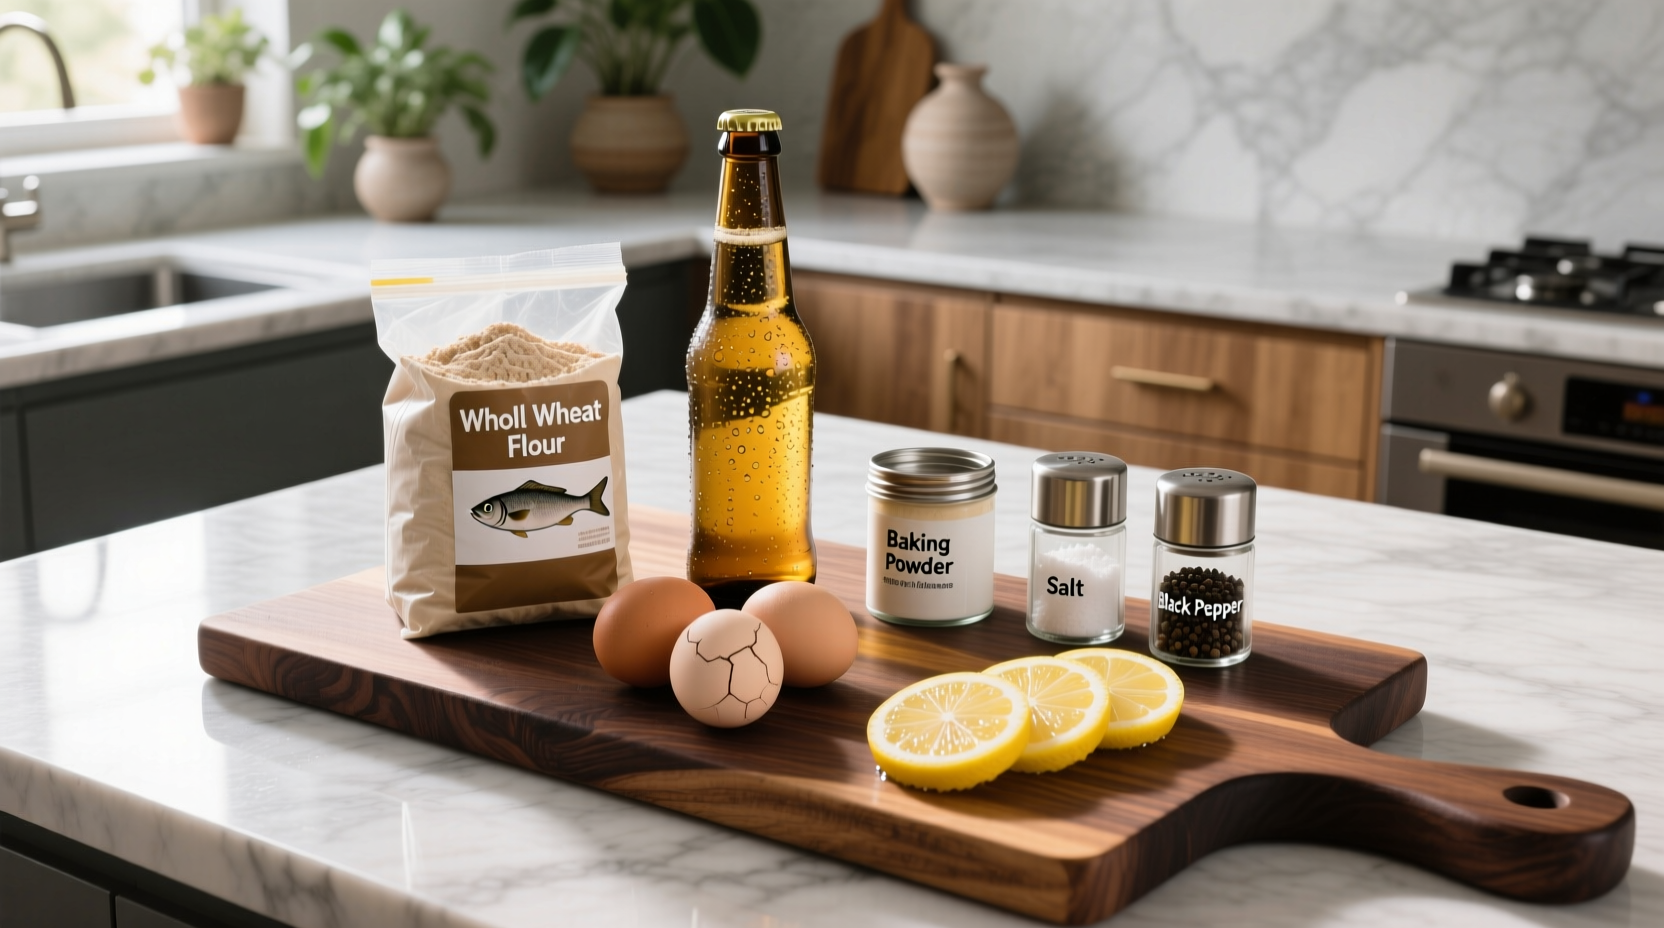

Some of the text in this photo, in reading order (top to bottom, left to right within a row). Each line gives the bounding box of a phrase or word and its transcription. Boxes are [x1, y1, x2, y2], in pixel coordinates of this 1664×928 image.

[459, 399, 602, 433] Wholl Wheat
[507, 433, 566, 458] Flour
[887, 529, 951, 556] Baking
[885, 552, 954, 575] Powder
[1046, 575, 1085, 597] Salt
[1158, 591, 1244, 622] Black Pepper
